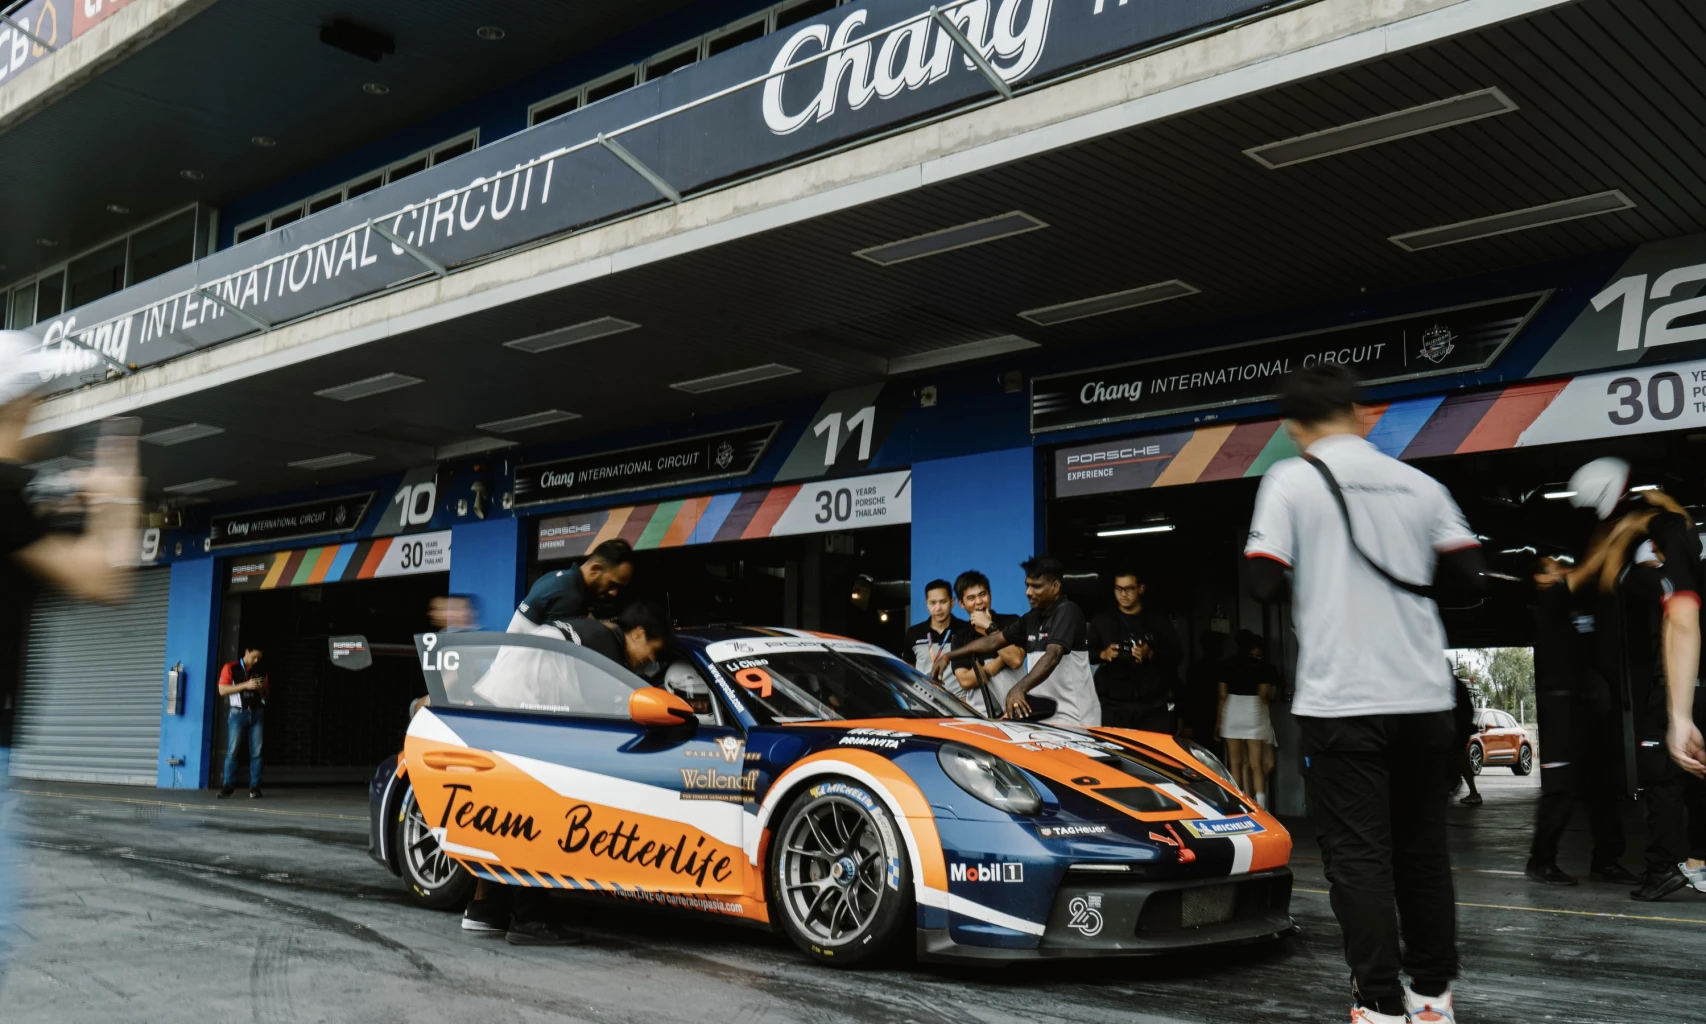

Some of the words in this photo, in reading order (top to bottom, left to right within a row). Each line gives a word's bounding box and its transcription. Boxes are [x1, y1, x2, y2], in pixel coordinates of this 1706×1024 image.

[762, 0, 1052, 135] Chang
[391, 147, 567, 256] CIRCUIT
[1590, 263, 1706, 352] 12
[1080, 380, 1143, 404] Chang
[1150, 358, 1293, 394] INTERNATIONAL
[1303, 343, 1386, 369] CIRCUIT
[1607, 371, 1685, 426] 30
[813, 406, 876, 466] 11
[1067, 445, 1160, 465] PORSCHE
[540, 471, 574, 488] Chang
[578, 461, 652, 482] INTERNATIONAL
[657, 452, 699, 470] CIRCUIT
[1067, 468, 1114, 481] EXPERIENCE
[395, 481, 437, 527] 10
[855, 486, 877, 496] YEARS
[855, 496, 886, 507] PORSCHE
[815, 488, 852, 524] 30
[855, 507, 887, 518] THAILAND
[227, 520, 249, 536] Chang
[540, 524, 591, 537] PORSCHE
[141, 528, 161, 561] 9
[401, 541, 424, 569] 30
[422, 632, 438, 652] 9
[422, 650, 460, 671] LIC
[726, 662, 740, 672] Li
[739, 658, 769, 669] Chao
[735, 667, 773, 698] 9
[838, 736, 899, 749] PRIMAVITA
[827, 782, 874, 808] MICHELIN
[439, 783, 542, 841] Team
[557, 804, 733, 888] Betterlife
[1211, 820, 1256, 832] MICHELIN
[950, 862, 1001, 882] Mobil
